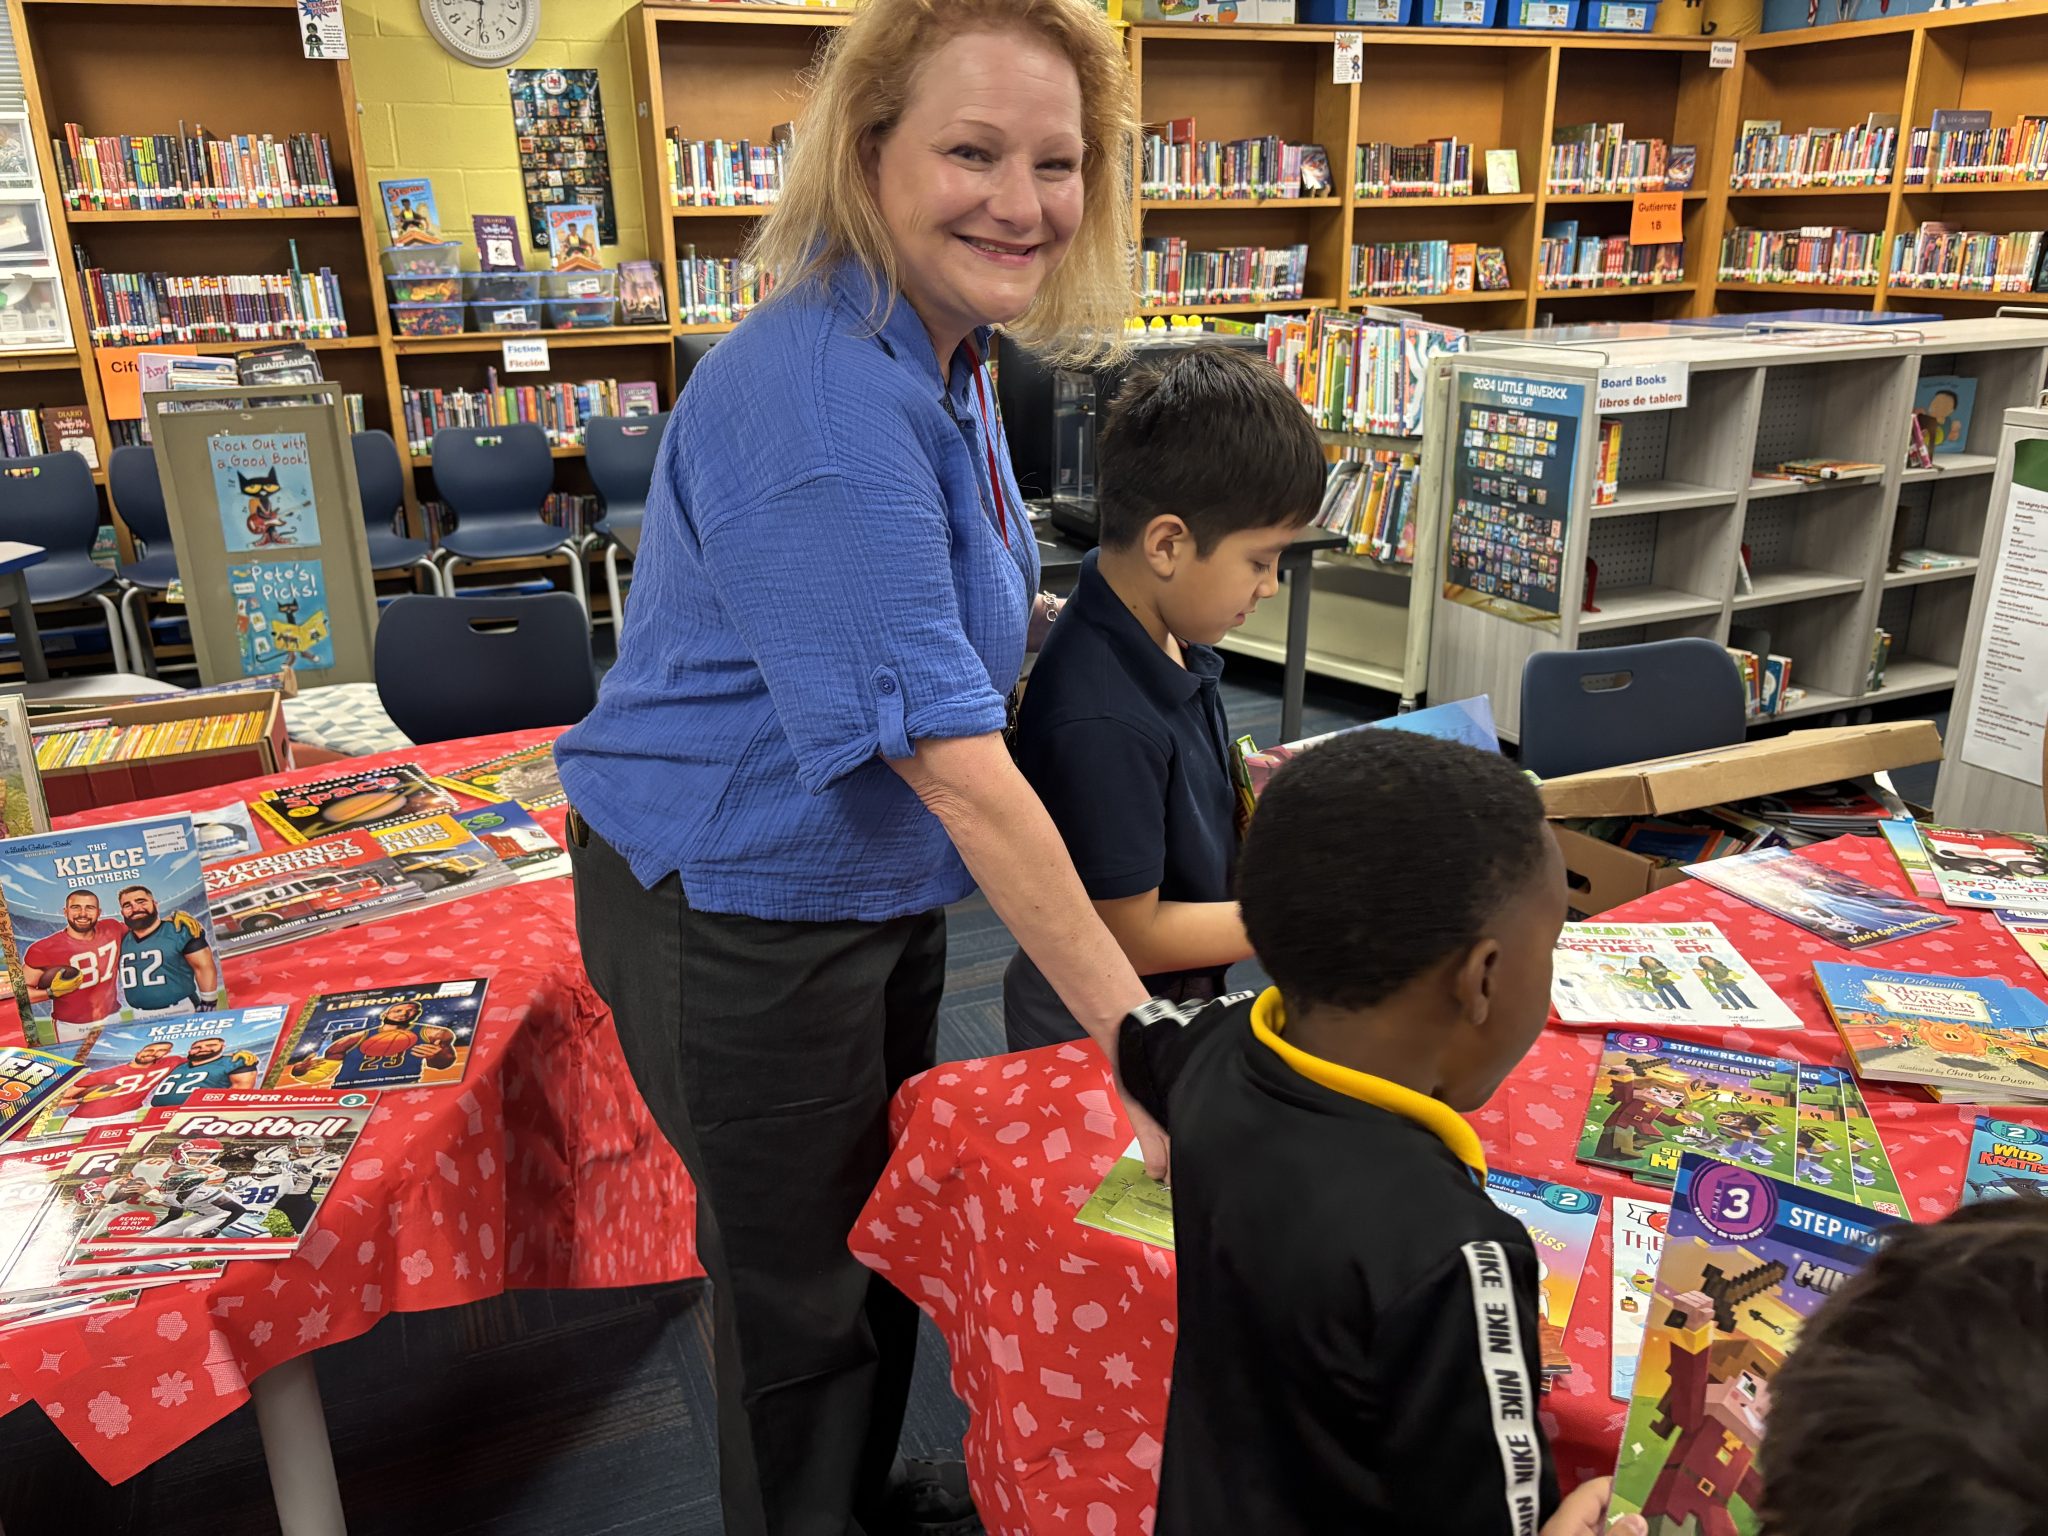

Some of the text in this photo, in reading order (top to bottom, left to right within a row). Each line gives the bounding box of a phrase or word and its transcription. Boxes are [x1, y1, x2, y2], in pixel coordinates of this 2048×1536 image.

[449, 13, 461, 24] 8
[464, 25, 475, 36] 7
[480, 31, 490, 44] 6
[496, 27, 505, 41] 5
[1713, 46, 1733, 54] Fiction
[507, 345, 542, 354] Fiction
[509, 359, 545, 368] Ficción
[1473, 377, 1568, 400] 2024 LITTLE MAVERICK
[1601, 375, 1667, 388] Board Books
[1501, 394, 1534, 407] BOOK LIST
[1599, 393, 1683, 409] libros de tablero
[213, 438, 306, 451] Rock Out with
[217, 451, 308, 469] a Good Book!
[251, 565, 310, 583] Pete's
[263, 574, 318, 600] Picks!
[87, 843, 107, 852] THE
[53, 848, 146, 878] KELCE
[202, 838, 353, 881] EMERGENCY
[206, 846, 365, 892] MACHINES
[68, 869, 140, 888] BROTHERS
[230, 931, 262, 942] WHICH
[264, 920, 306, 938] MACHINE
[319, 909, 343, 920] BEST
[344, 904, 360, 913] FOR
[362, 900, 381, 910] THE
[1848, 915, 1941, 944] Elsa's Epic Journey
[69, 940, 166, 989] 87 62
[1872, 973, 1966, 990] Kate DiCamillo
[1887, 984, 1954, 1001] Mercy
[1894, 993, 1974, 1010] Watson
[148, 1018, 235, 1037] KELCE
[153, 1028, 224, 1042] BROTHERS
[1638, 1037, 1648, 1047] 3
[359, 1051, 405, 1071] 23
[1670, 1042, 1699, 1053] STEP
[1700, 1048, 1719, 1056] INTO
[1719, 1052, 1777, 1067] READING
[1674, 1057, 1773, 1080] MINECRAFT
[1897, 1064, 1934, 1074] illustrated
[1946, 1068, 1974, 1079] Chris
[1977, 1072, 1997, 1082] Van
[2000, 1075, 2036, 1087] Dusen
[111, 1067, 209, 1097] 87 62
[205, 1093, 357, 1104] DK SUPER Readers 3
[180, 1117, 349, 1137] Football
[2006, 1127, 2025, 1139] 2
[1980, 1151, 2048, 1175] KRATTS
[1489, 1183, 1515, 1194] reading
[1515, 1190, 1532, 1198] with
[1560, 1193, 1578, 1206] 2
[1722, 1188, 1750, 1220] 3
[1694, 1207, 1717, 1233] READING
[1717, 1230, 1728, 1239] ON
[1748, 1227, 1764, 1238] OWN
[1789, 1207, 1841, 1237] STEP
[1527, 1225, 1568, 1252] Kiss
[1484, 1303, 1512, 1355] NIKE
[1493, 1369, 1524, 1421] NIKE
[1506, 1434, 1535, 1485] NIKE
